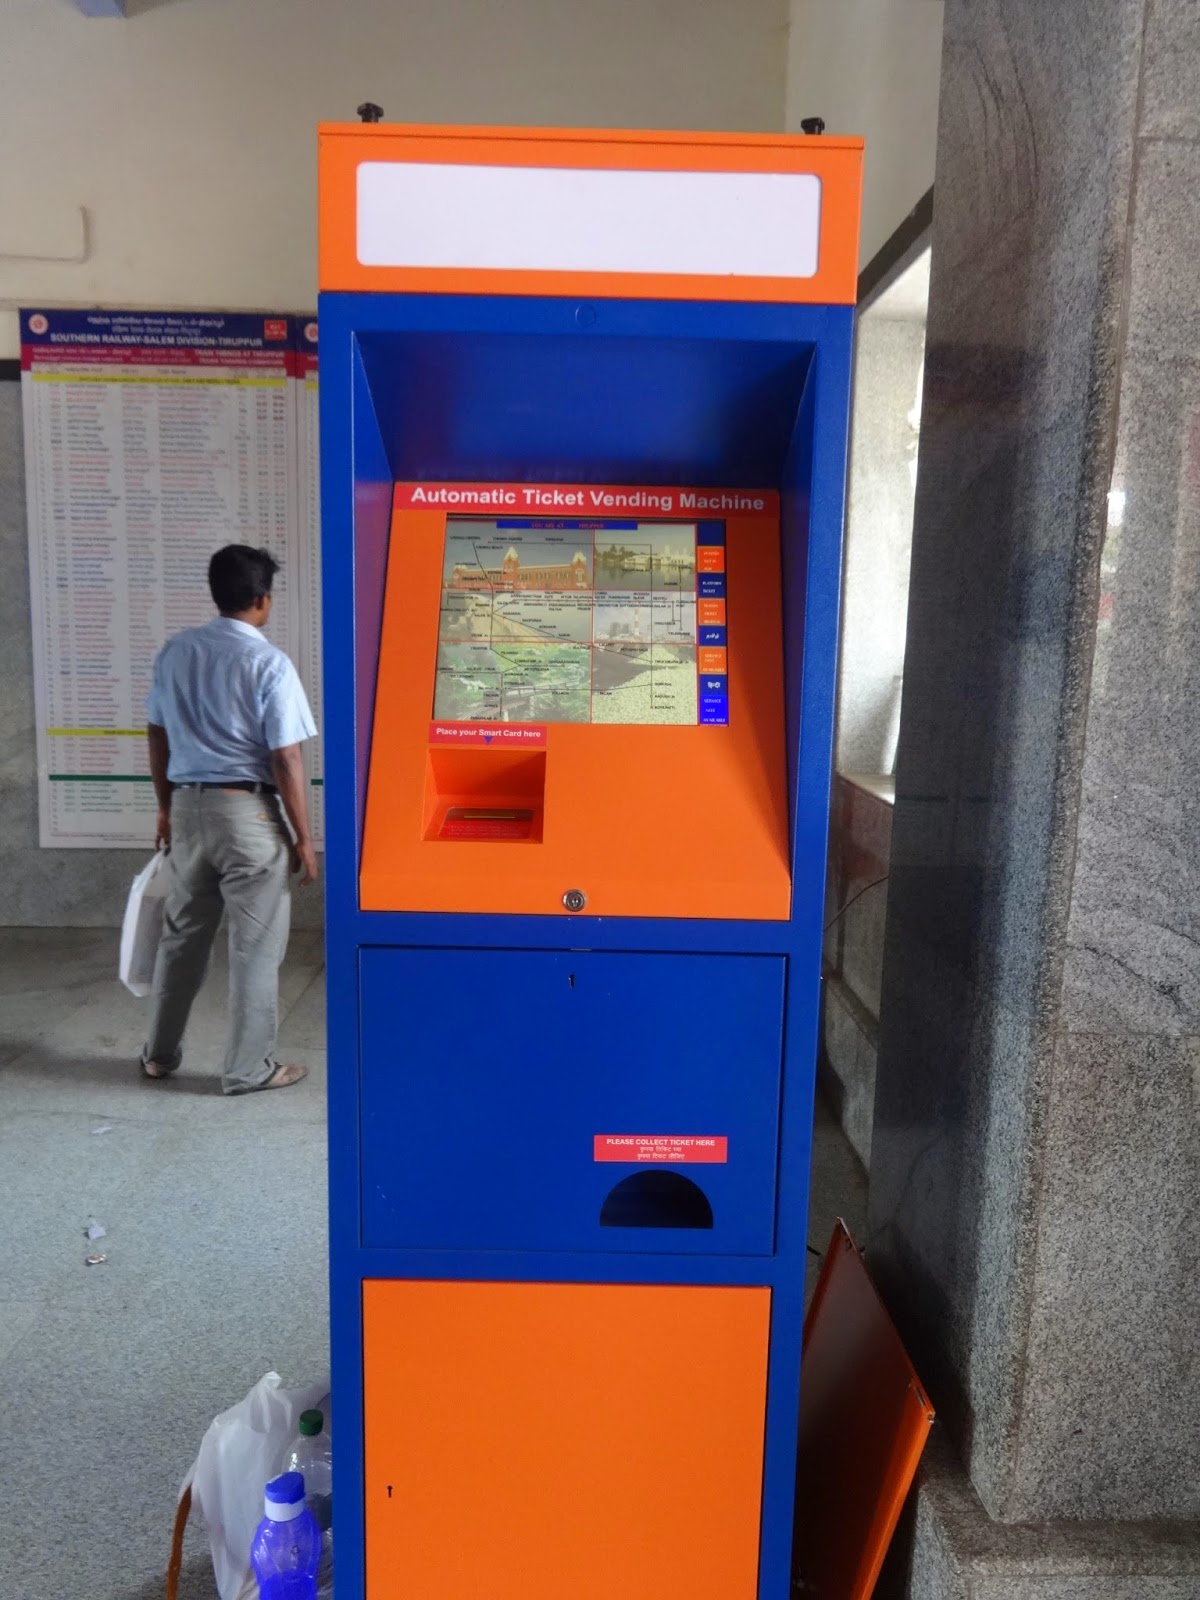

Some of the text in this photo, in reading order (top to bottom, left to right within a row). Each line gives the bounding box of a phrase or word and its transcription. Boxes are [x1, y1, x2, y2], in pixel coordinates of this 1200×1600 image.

[50, 333, 100, 343] SOUTHERN
[411, 487, 765, 512] Automatic Ticket Vending Machine
[436, 727, 458, 735] Place
[459, 729, 477, 737] your
[478, 728, 502, 737] Smart
[503, 729, 522, 737] Card
[635, 1138, 668, 1146] COLLECT
